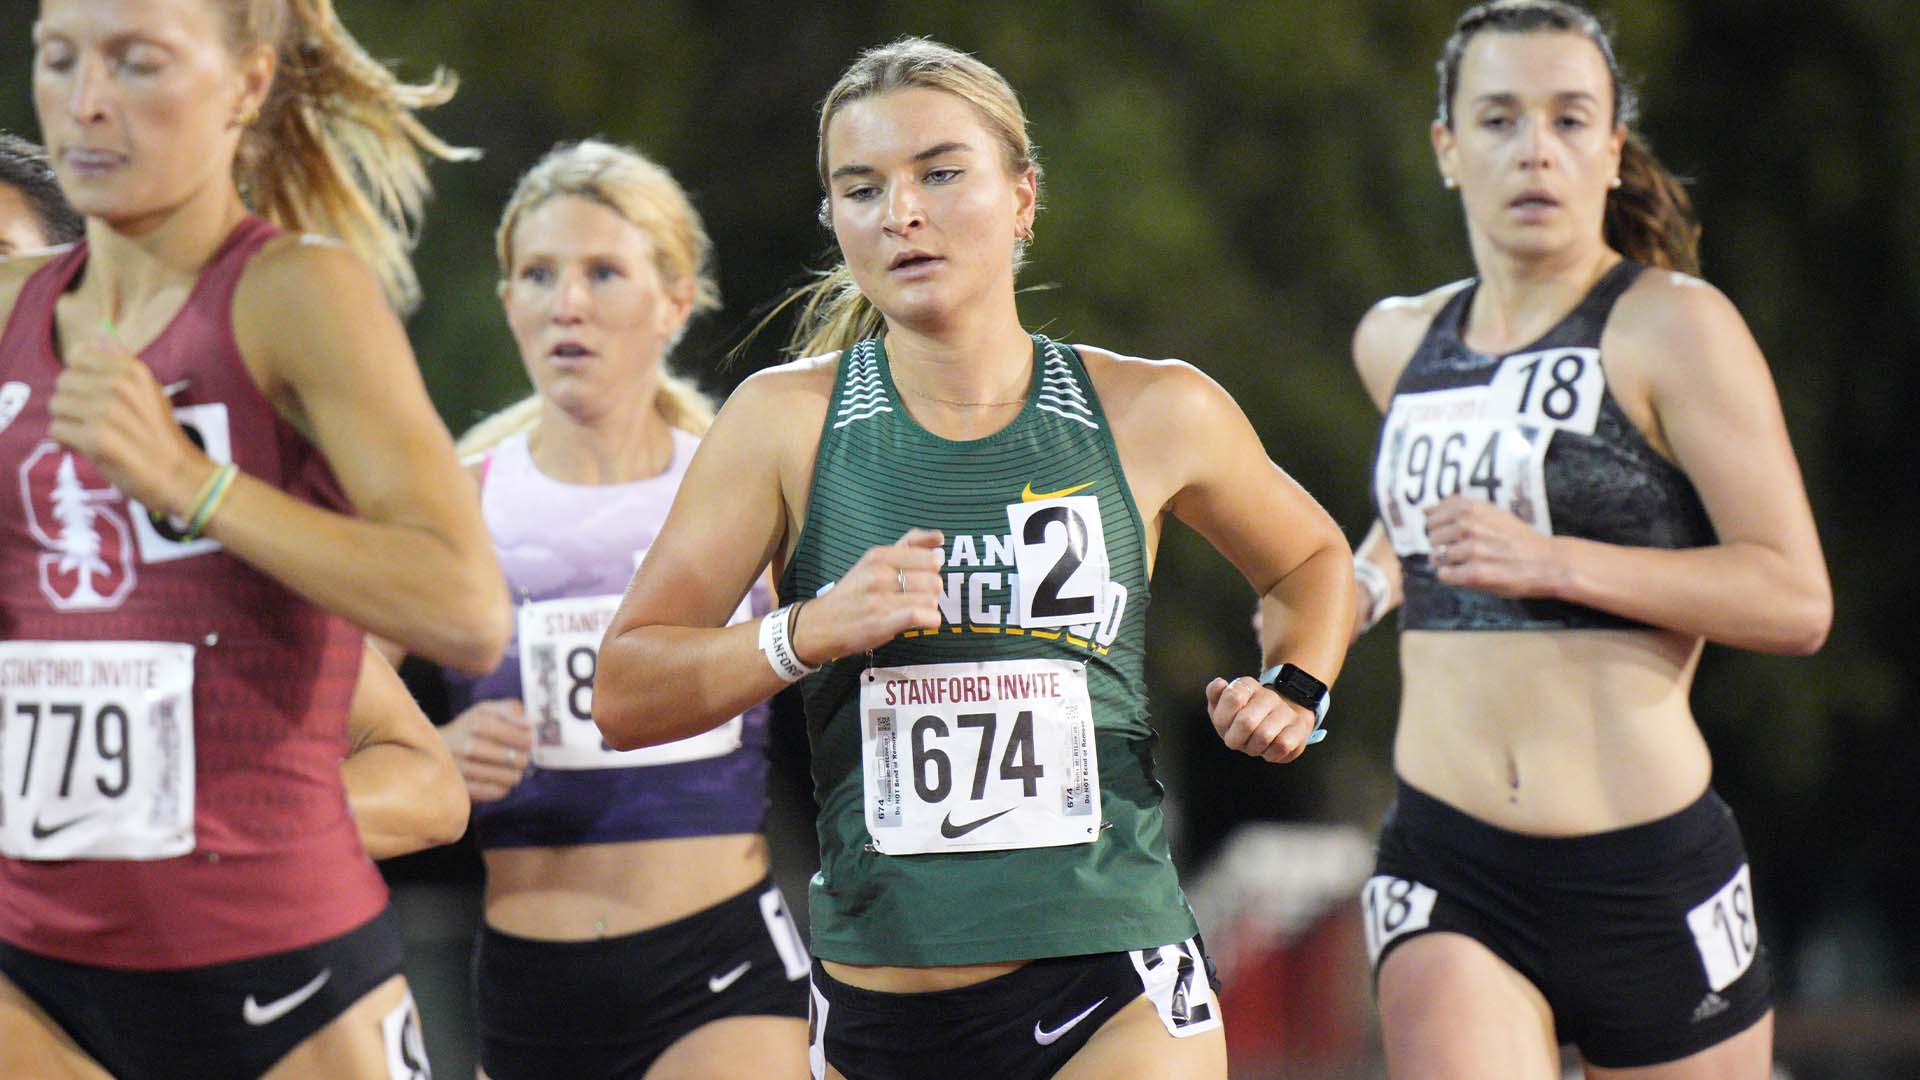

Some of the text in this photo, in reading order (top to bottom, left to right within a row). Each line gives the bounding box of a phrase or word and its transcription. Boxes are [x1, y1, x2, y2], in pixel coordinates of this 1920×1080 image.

[1517, 354, 1585, 421] 18
[1404, 431, 1503, 506] 964
[1022, 505, 1095, 619] 2
[0, 656, 159, 689] STANFORD INVITE
[885, 672, 1062, 706] STANFORD INVITE
[15, 702, 131, 799] 779
[910, 710, 1045, 804] 674
[877, 799, 885, 820] 674
[894, 806, 900, 816] Do
[1066, 787, 1074, 809] 674
[1084, 794, 1090, 804] Do
[1369, 878, 1416, 946] 18
